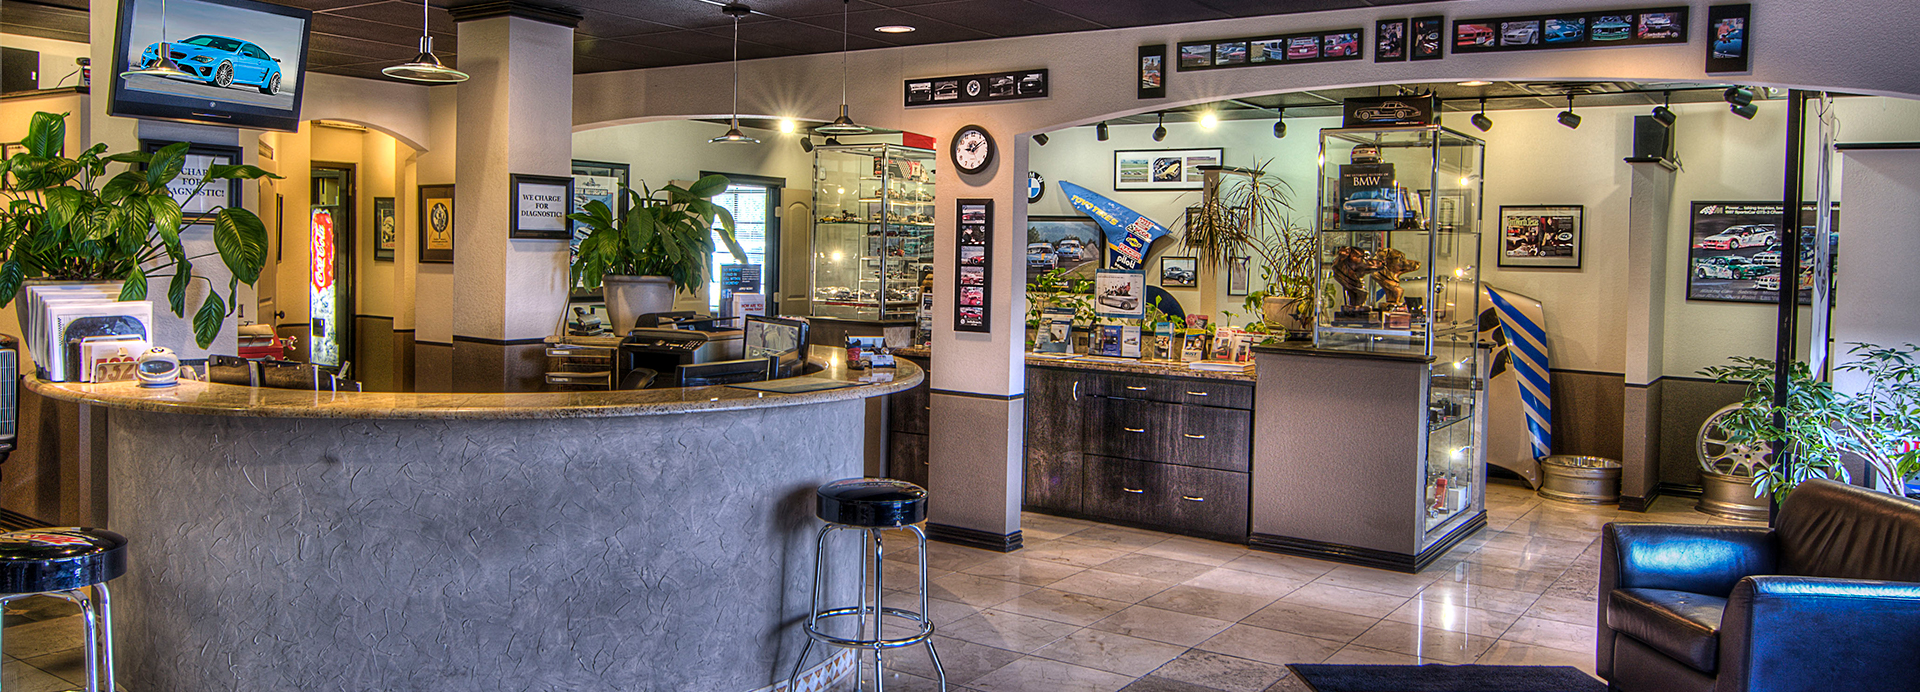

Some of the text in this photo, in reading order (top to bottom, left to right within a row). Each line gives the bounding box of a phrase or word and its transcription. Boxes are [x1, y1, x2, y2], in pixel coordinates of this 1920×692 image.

[1353, 176, 1380, 186] BMW
[171, 187, 225, 198] AGNSTIC!
[1071, 195, 1094, 210] TOYO
[1092, 206, 1119, 226] TIRES
